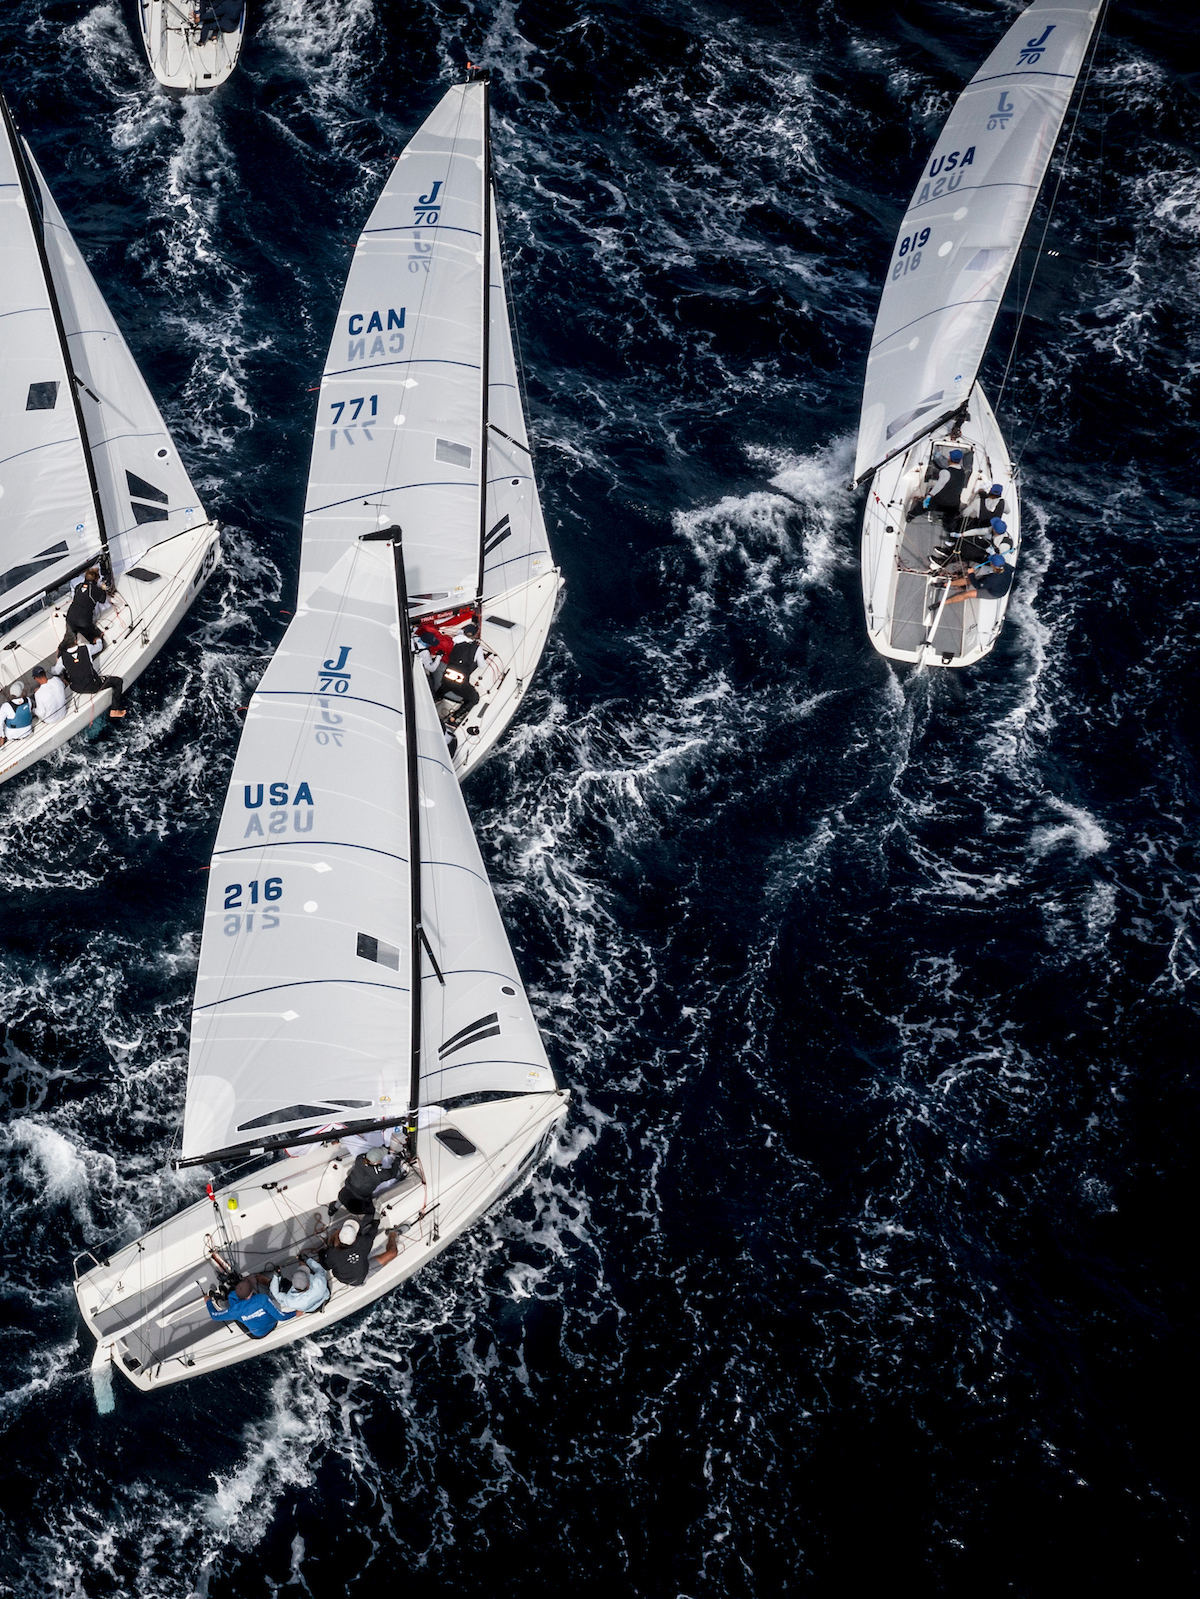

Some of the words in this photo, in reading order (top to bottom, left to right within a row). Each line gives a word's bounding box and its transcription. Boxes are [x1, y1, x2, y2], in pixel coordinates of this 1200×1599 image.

[1027, 25, 1056, 47] J
[1016, 52, 1041, 66] 70
[929, 146, 976, 178] USA
[419, 181, 443, 204] J
[414, 211, 438, 225] 70
[899, 227, 931, 257] 819
[349, 307, 406, 335] CAN
[331, 395, 378, 425] 771
[323, 646, 352, 671] J
[319, 678, 349, 693] 70
[244, 782, 314, 808] USA
[224, 877, 283, 909] 216
